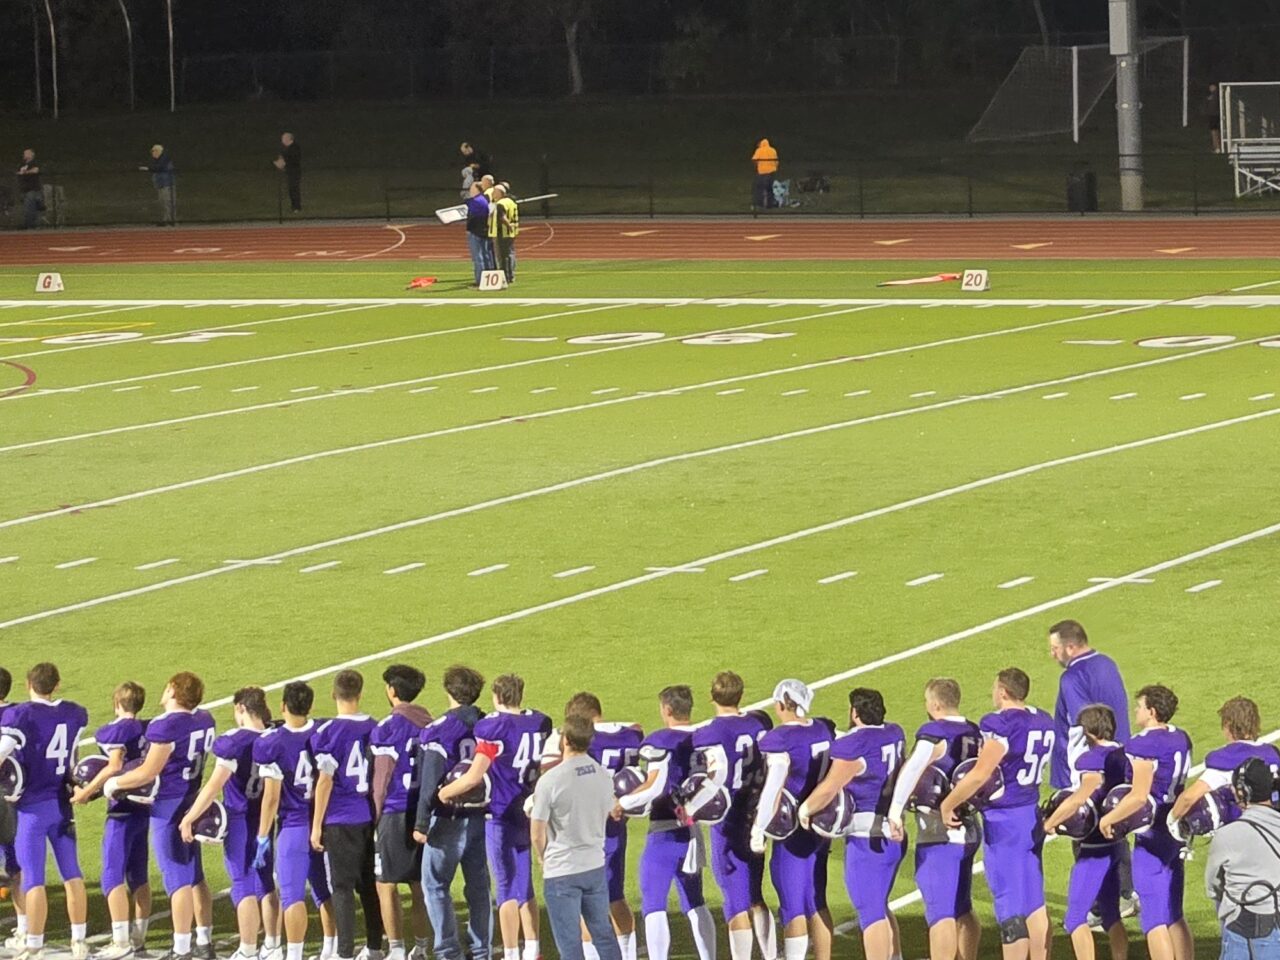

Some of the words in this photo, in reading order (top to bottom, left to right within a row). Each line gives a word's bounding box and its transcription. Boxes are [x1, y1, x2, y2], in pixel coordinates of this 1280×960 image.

[42, 275, 52, 289] G
[485, 273, 499, 287] 10
[964, 273, 983, 287] 20
[46, 723, 68, 775] 4
